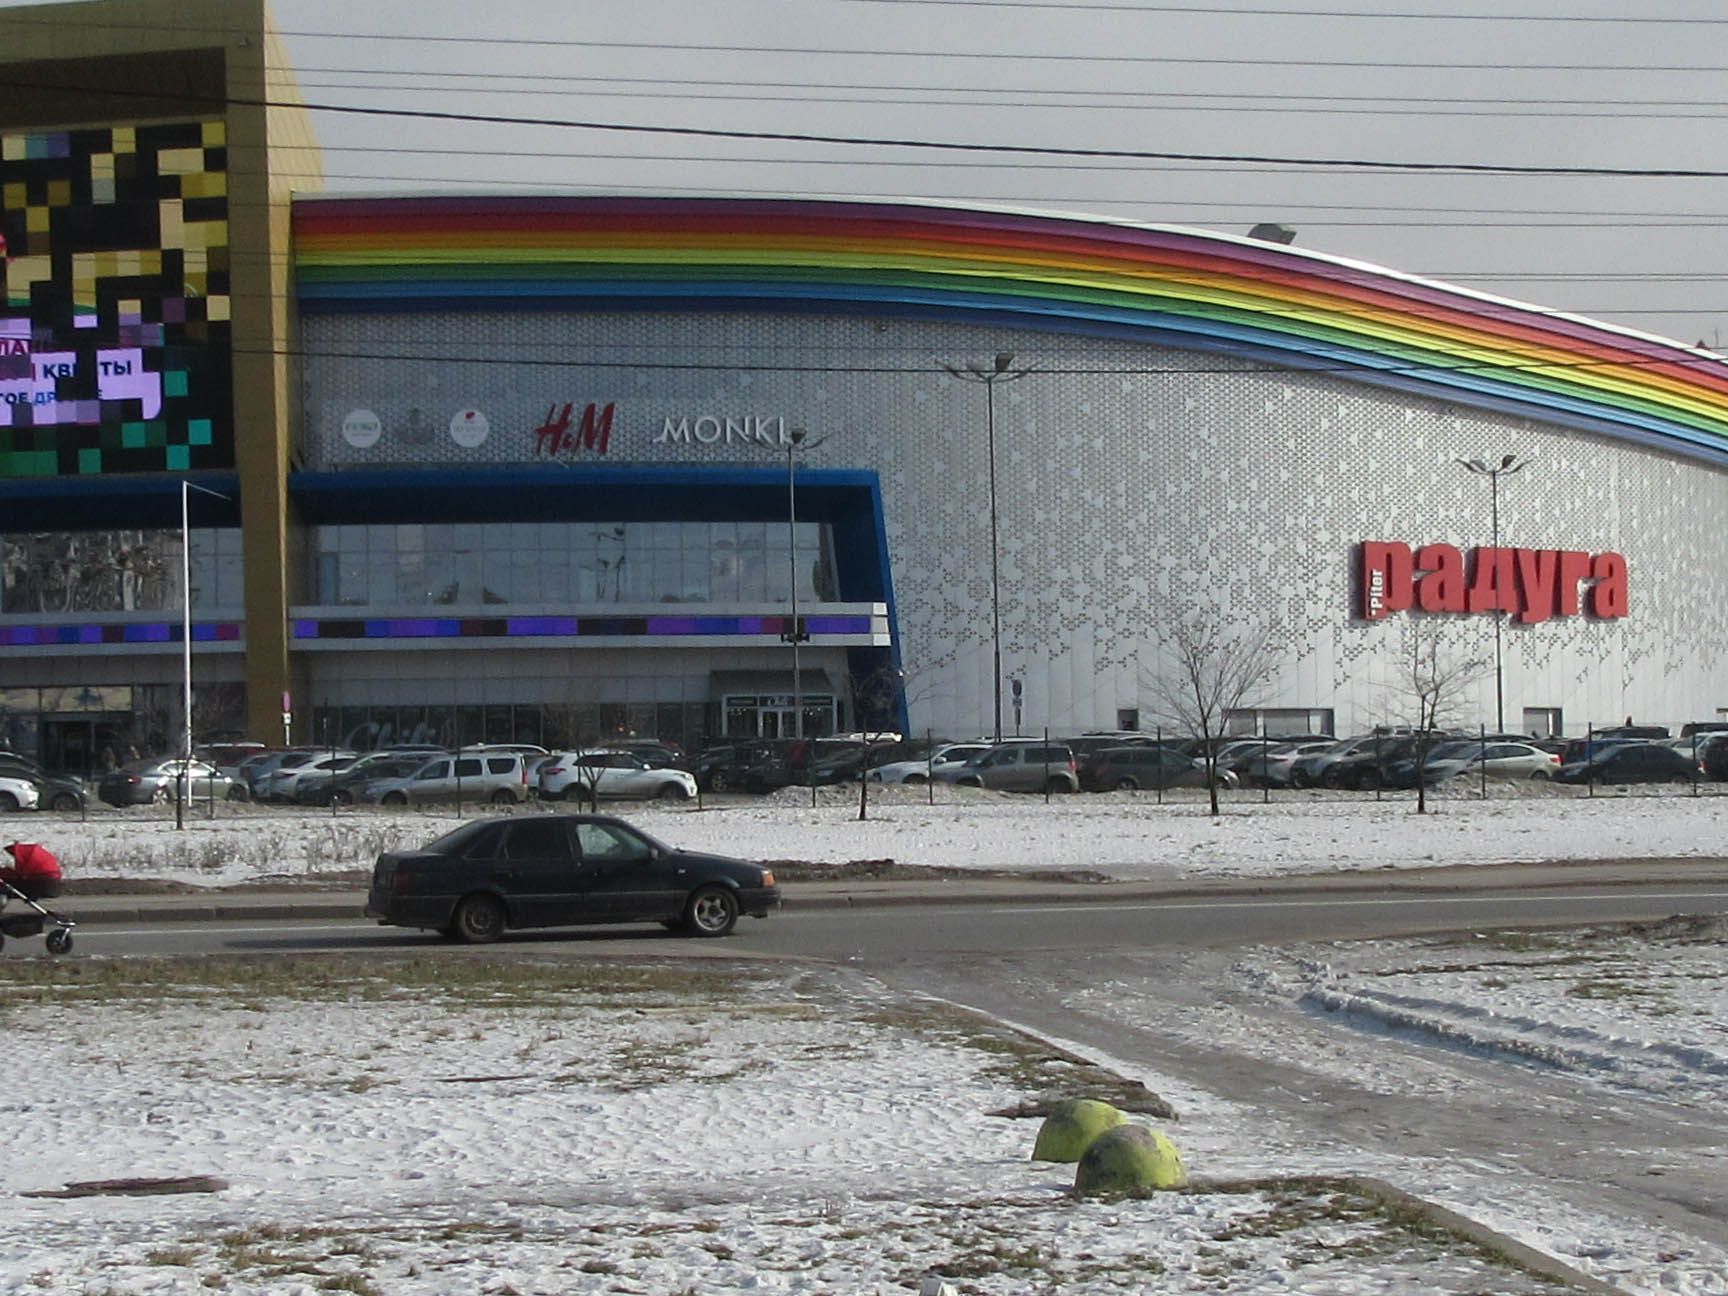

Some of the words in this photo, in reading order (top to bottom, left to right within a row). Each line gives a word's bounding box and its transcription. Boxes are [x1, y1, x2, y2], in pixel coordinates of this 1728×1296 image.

[535, 403, 616, 455] H&M
[652, 415, 791, 444] MONKI
[1363, 540, 1628, 624] радуга
